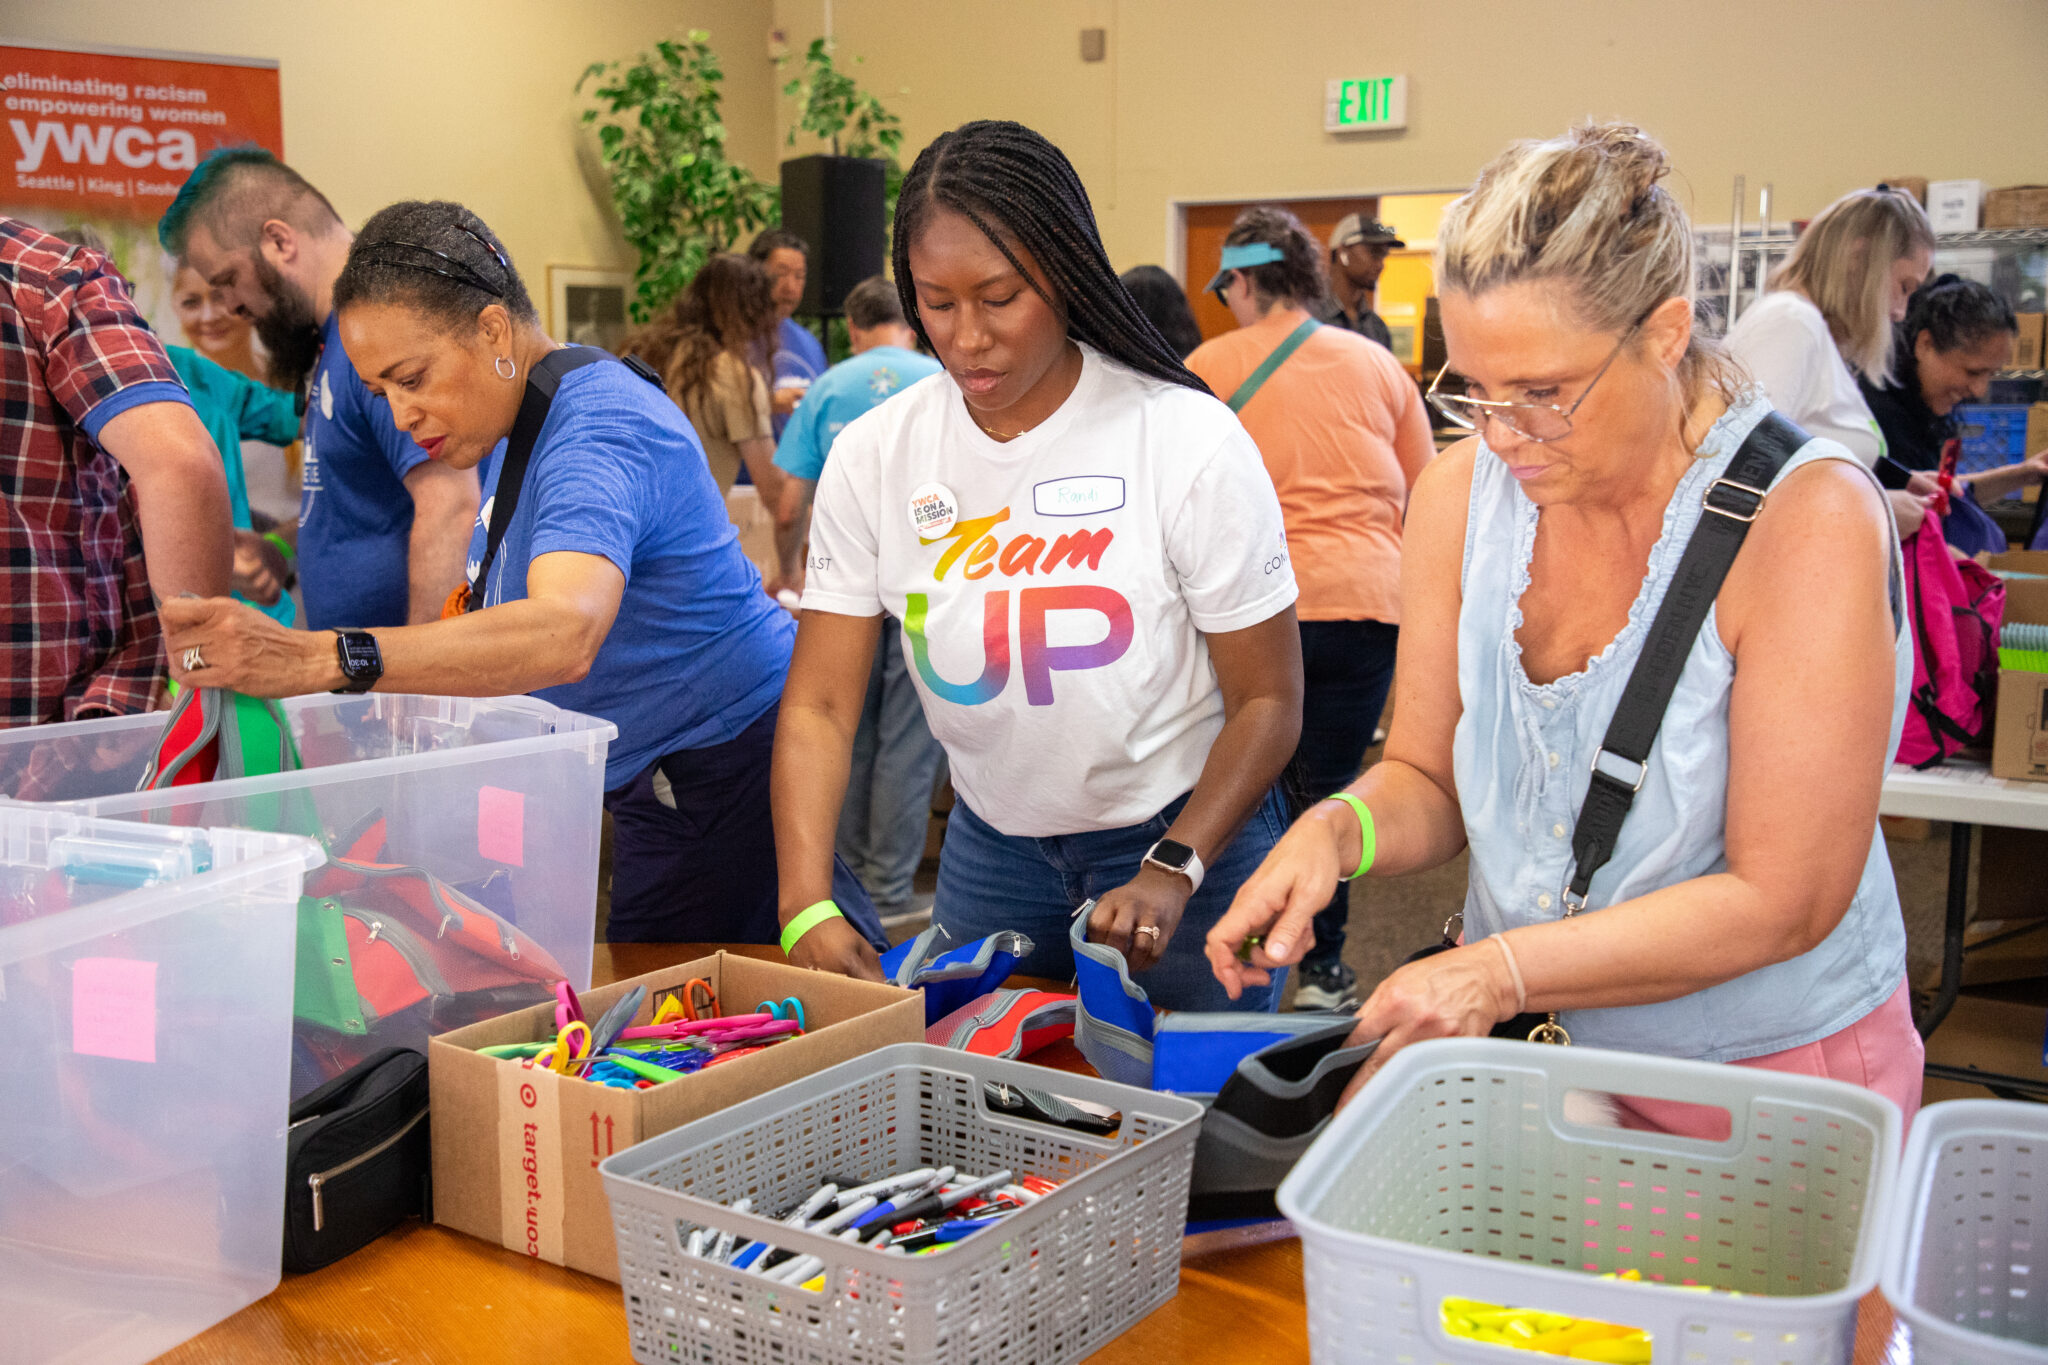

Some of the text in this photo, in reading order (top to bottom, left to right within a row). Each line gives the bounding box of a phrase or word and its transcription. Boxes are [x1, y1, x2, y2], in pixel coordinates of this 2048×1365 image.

[3, 72, 207, 104] eliminating racism
[1340, 78, 1393, 124] EXIT
[5, 96, 227, 126] empowering women
[9, 118, 197, 173] ywca
[17, 173, 75, 191] Seattle
[87, 177, 125, 197] King
[912, 493, 940, 508] YWCA
[914, 500, 945, 517] IS ON A
[1057, 486, 1099, 504] Randi
[916, 506, 953, 525] MISSION
[919, 506, 1114, 582] Team
[905, 585, 1134, 706] UP
